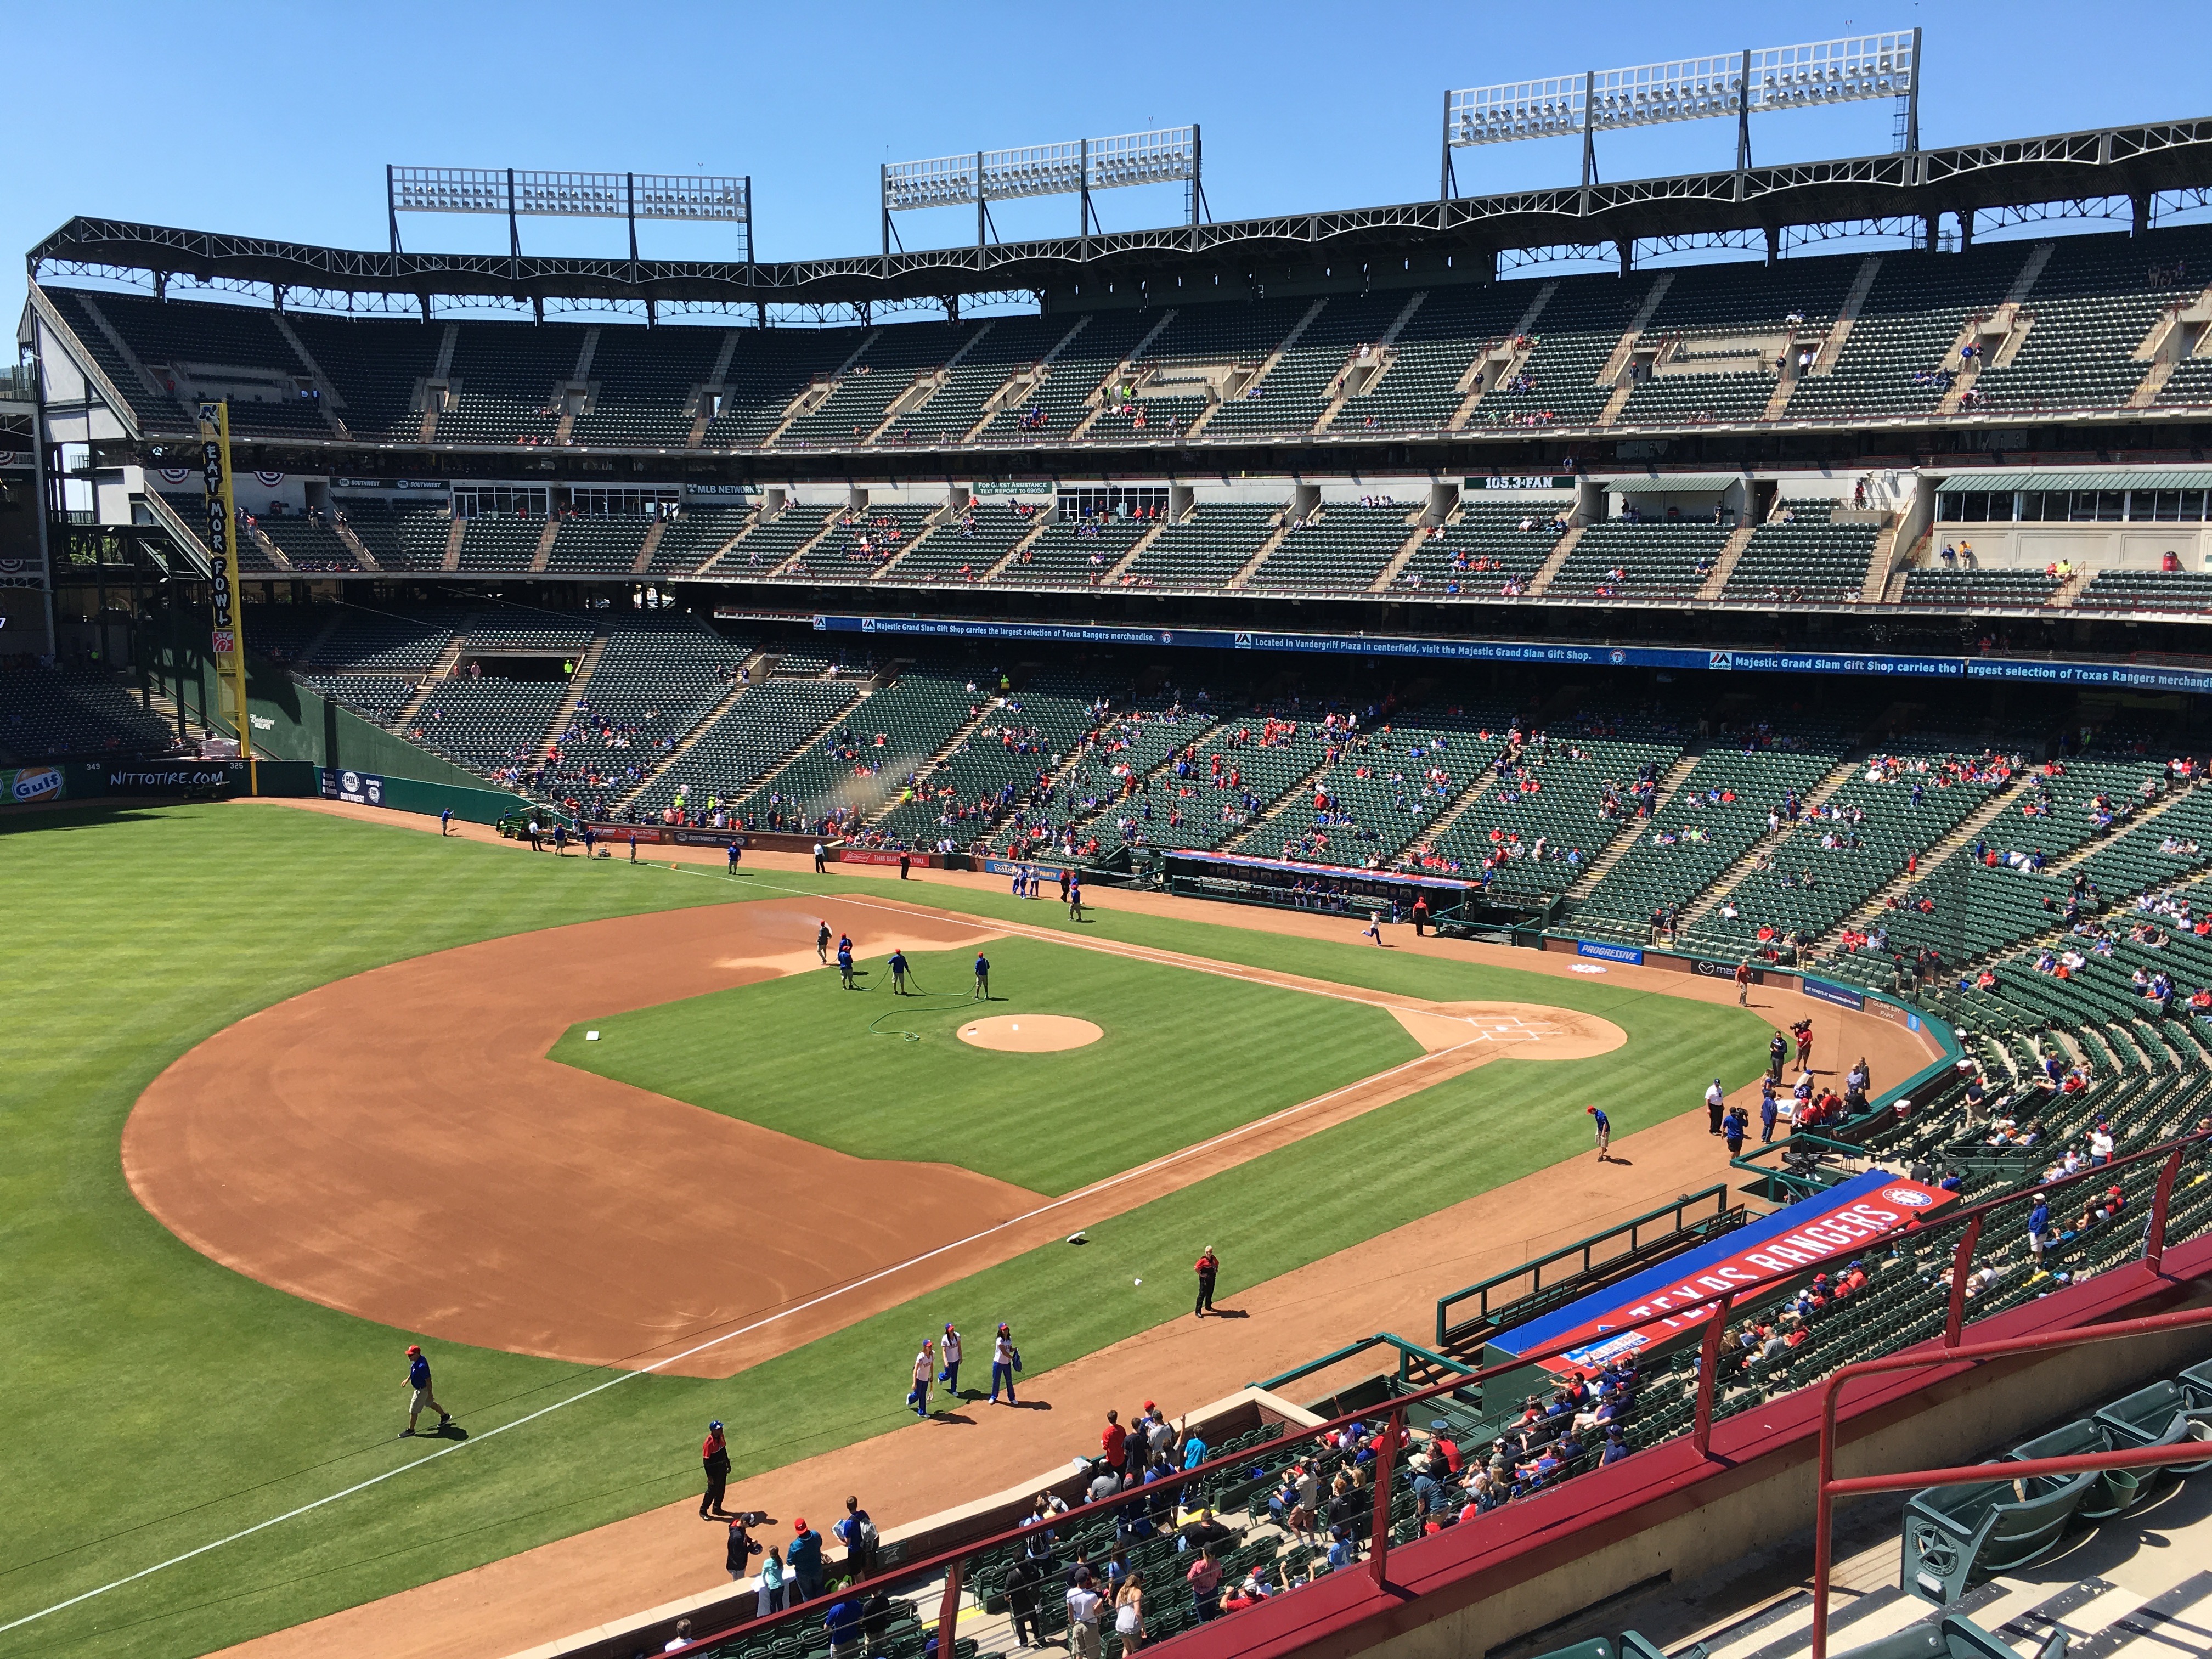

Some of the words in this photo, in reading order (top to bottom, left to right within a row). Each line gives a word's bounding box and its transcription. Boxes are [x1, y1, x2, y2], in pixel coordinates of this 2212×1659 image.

[207, 444, 218, 493] EAT
[697, 485, 716, 493] MLB
[719, 486, 755, 494] NETWORK
[1486, 477, 1521, 489] 105.3
[1526, 477, 1553, 488] FAN
[211, 503, 223, 550] MOR
[215, 560, 228, 624] FOWL
[877, 622, 901, 631] Majestic
[902, 623, 919, 631] Grand
[936, 624, 949, 633] Gift
[950, 625, 964, 634] Shop
[1000, 628, 1022, 637] largest
[1062, 630, 1080, 638] Texas
[1082, 631, 1109, 640] Rangers
[1111, 632, 1155, 641] merchandise.
[1255, 638, 1284, 647] Located
[1286, 639, 1293, 647] in
[1295, 640, 1339, 650] Vandergriff
[1341, 641, 1361, 650] Plaza
[1363, 642, 1370, 651] in
[1373, 644, 1419, 654] centerfield,
[1422, 645, 1439, 653] visit
[1442, 646, 1455, 654] the
[1458, 646, 1493, 657] Majestic
[1496, 648, 1521, 657] Grand
[1523, 649, 1544, 658] Slam
[1548, 650, 1564, 659] Gift
[1566, 651, 1592, 661] Shop.
[1736, 657, 1778, 668] Majestic
[1781, 658, 1812, 668] Grand
[1815, 659, 1840, 669] Slam
[1844, 661, 1864, 670] Gift
[1867, 661, 1894, 673] Shop
[1897, 663, 1935, 673] carries
[1938, 664, 1956, 673] the
[2005, 667, 2056, 678] selection
[2060, 669, 2072, 679] of
[2075, 669, 2108, 681] Texas
[2112, 670, 2155, 684] Rangers
[16, 774, 58, 797] Gulf
[110, 770, 224, 786] NITTOTIRE.COM
[346, 775, 356, 785] FOX
[340, 792, 365, 803] SOUTHWEST
[1581, 945, 1638, 961] PROGRESSIVE
[1872, 1000, 1891, 1011] GLOBE
[1880, 1010, 1894, 1019] PARK
[1745, 1204, 1899, 1271] RANGERS
[1576, 1351, 1605, 1364] GLBE
[1619, 1333, 1641, 1348] PARK
